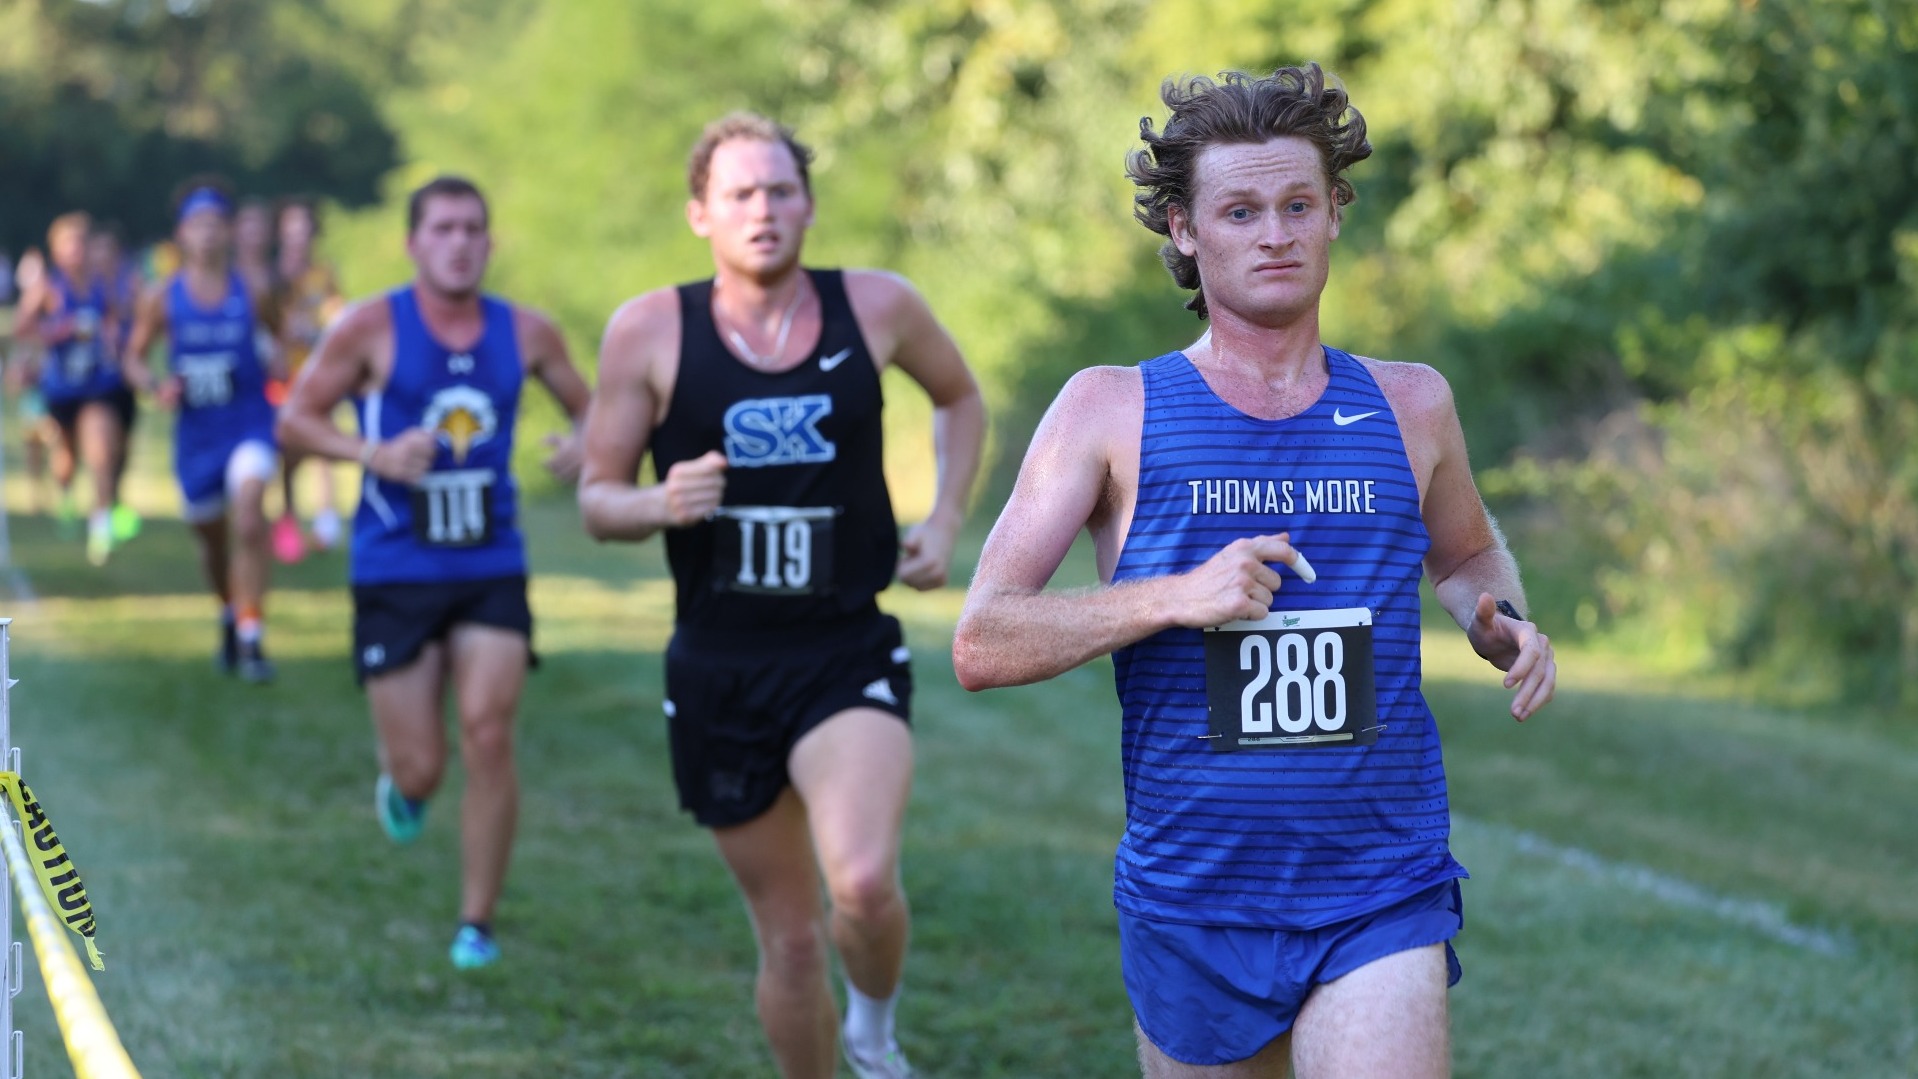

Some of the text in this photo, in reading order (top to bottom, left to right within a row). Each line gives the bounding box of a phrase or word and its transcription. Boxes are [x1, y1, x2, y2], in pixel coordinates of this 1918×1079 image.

[723, 395, 835, 467] SK
[1188, 480, 1376, 514] THOMAS MORE
[737, 519, 811, 588] 119
[1240, 631, 1347, 733] 288
